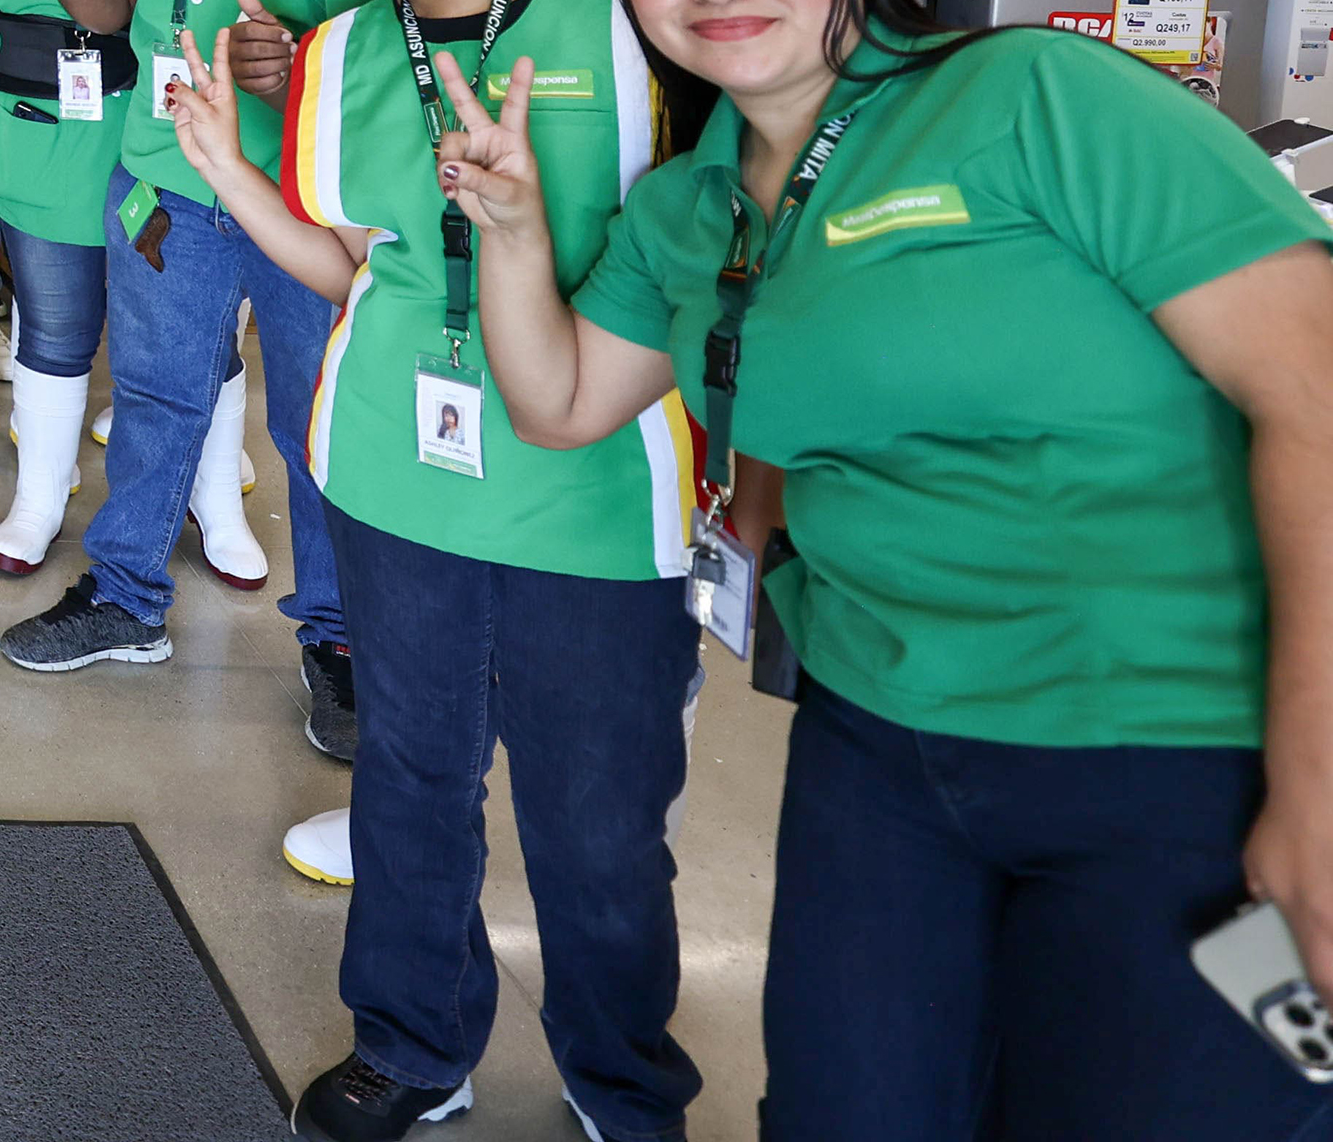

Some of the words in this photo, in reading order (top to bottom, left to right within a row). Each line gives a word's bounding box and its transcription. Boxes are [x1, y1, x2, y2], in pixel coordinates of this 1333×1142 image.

[1156, 23, 1191, 33] Q249,17
[416, 64, 433, 87] MD
[799, 137, 835, 181] MITA
